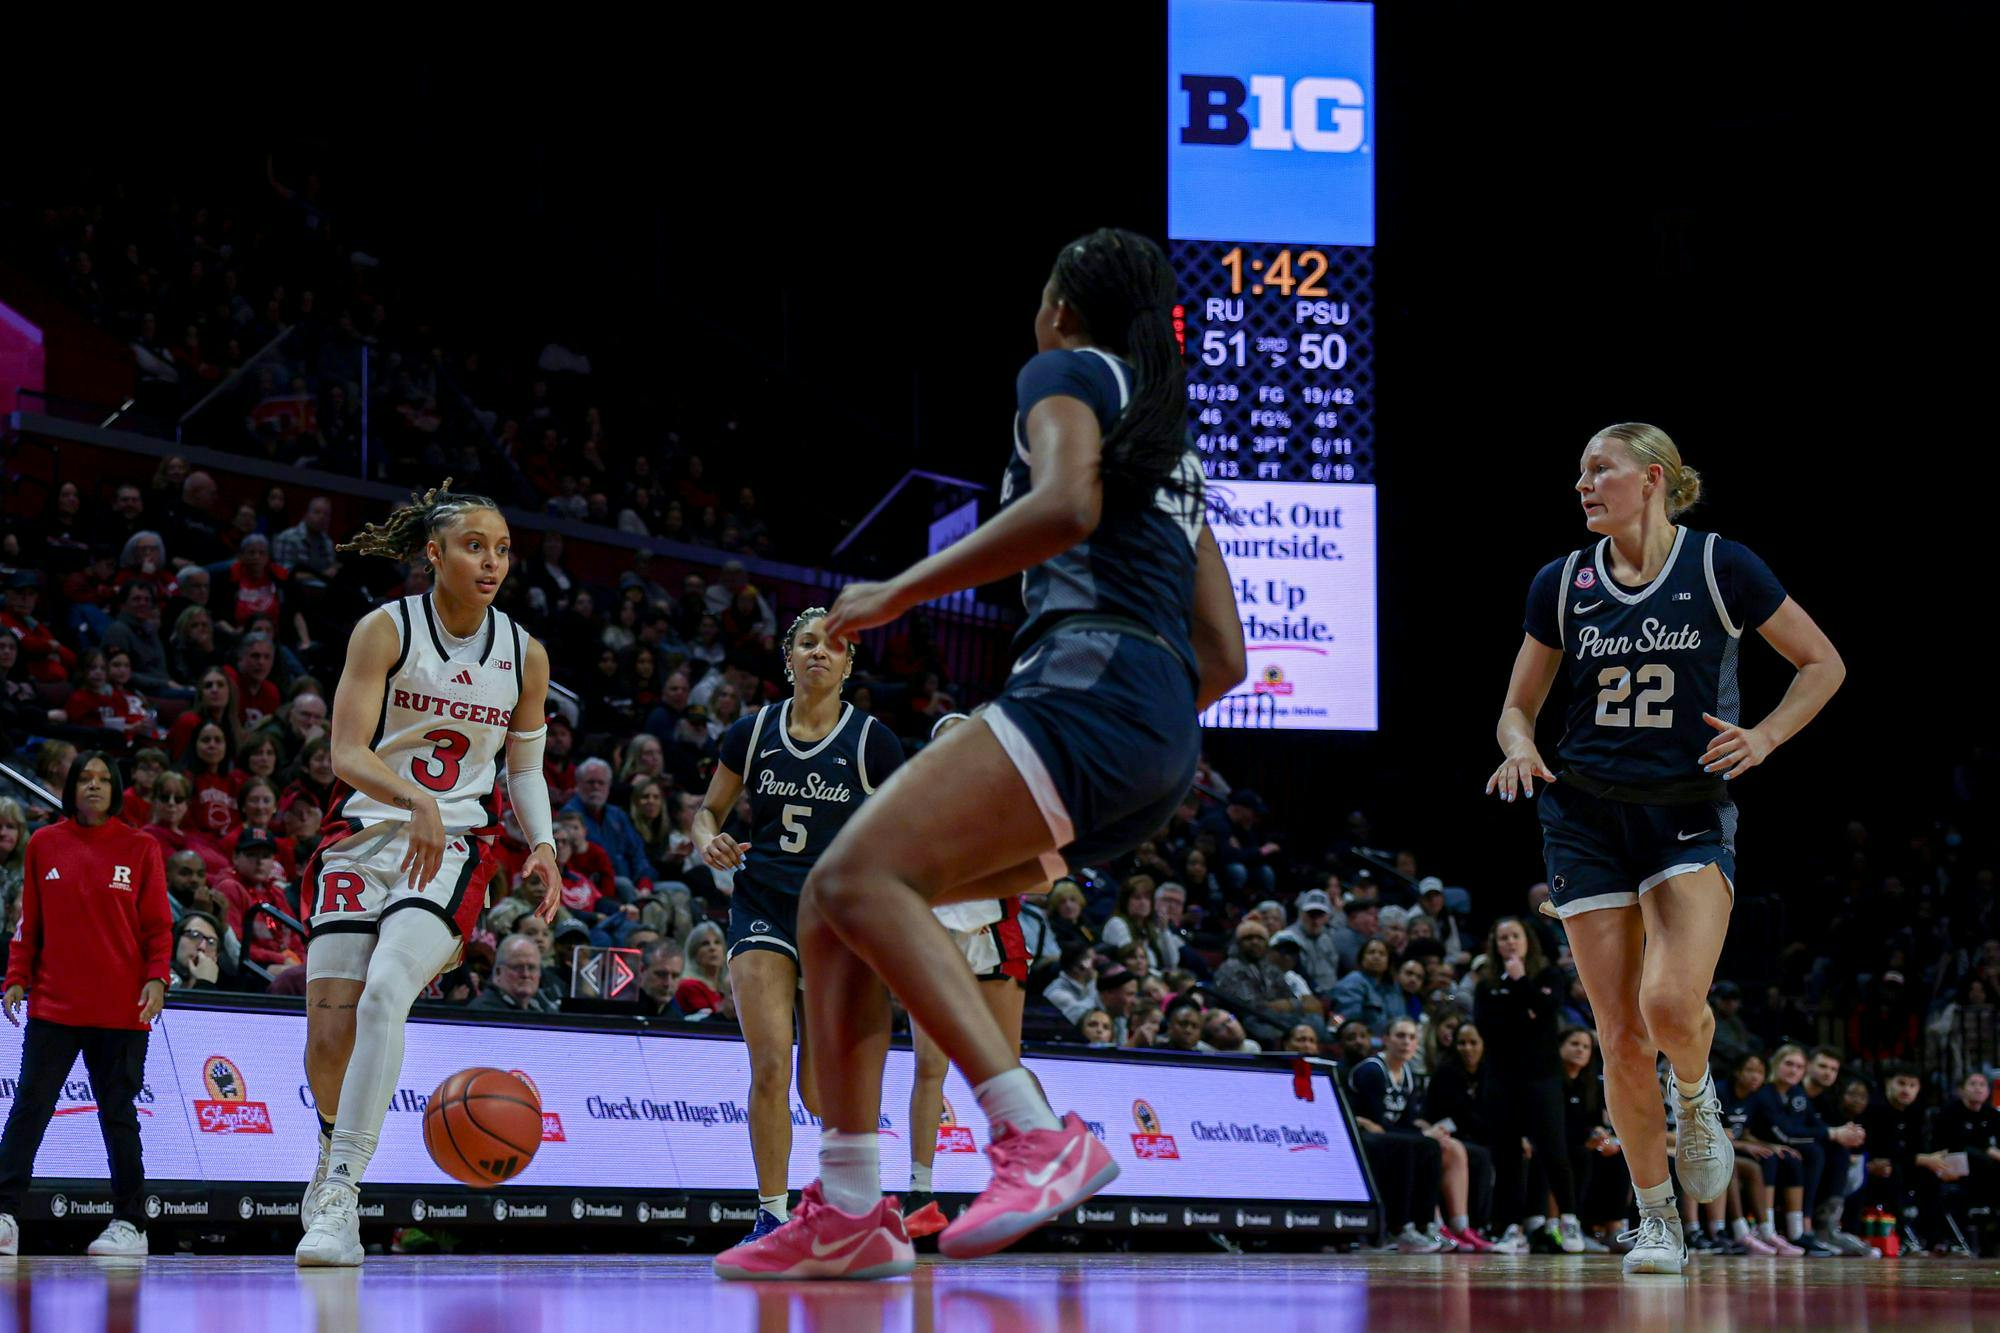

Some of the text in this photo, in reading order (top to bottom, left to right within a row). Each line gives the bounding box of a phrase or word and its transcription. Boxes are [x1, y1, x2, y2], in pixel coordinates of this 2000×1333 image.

[1222, 248, 1329, 296] 1:42
[1207, 298, 1244, 321] RU
[1296, 302, 1350, 325] PSU
[1202, 330, 1246, 367] 51
[1298, 333, 1347, 370] 50
[1259, 386, 1285, 403] FG
[1302, 387, 1354, 407] 19/42
[1199, 408, 1222, 425] 46
[1251, 410, 1292, 428] FG%
[1314, 411, 1338, 429] 45
[1196, 434, 1239, 454] 4/14
[1253, 436, 1288, 453] 3PT
[1311, 437, 1352, 458] 6/11
[1258, 462, 1281, 479] FT
[1211, 501, 1343, 528] heck Out
[1218, 535, 1343, 561] ourtside.
[1266, 580, 1306, 611] Up
[1244, 616, 1334, 642] rbside.
[1576, 617, 1701, 661] Penn State
[1595, 664, 1675, 728] 22
[394, 689, 512, 728] RUTGERS
[411, 729, 471, 792] 3
[757, 769, 850, 803] Penn State
[779, 803, 812, 853] 5
[112, 865, 132, 884] R
[320, 871, 367, 914] R
[586, 1095, 642, 1121] Check
[641, 1099, 675, 1122] Out
[673, 1101, 719, 1127] Huge
[1191, 1121, 1329, 1148] Check Out Easy Buckets
[70, 1200, 114, 1214] Prudentia
[164, 1202, 208, 1215] Prudential
[257, 1203, 299, 1216] Prudential
[428, 1205, 467, 1218] Prudential
[509, 1205, 547, 1218] Prudential
[586, 1204, 622, 1217] Prudential
[651, 1207, 686, 1219] Prudential
